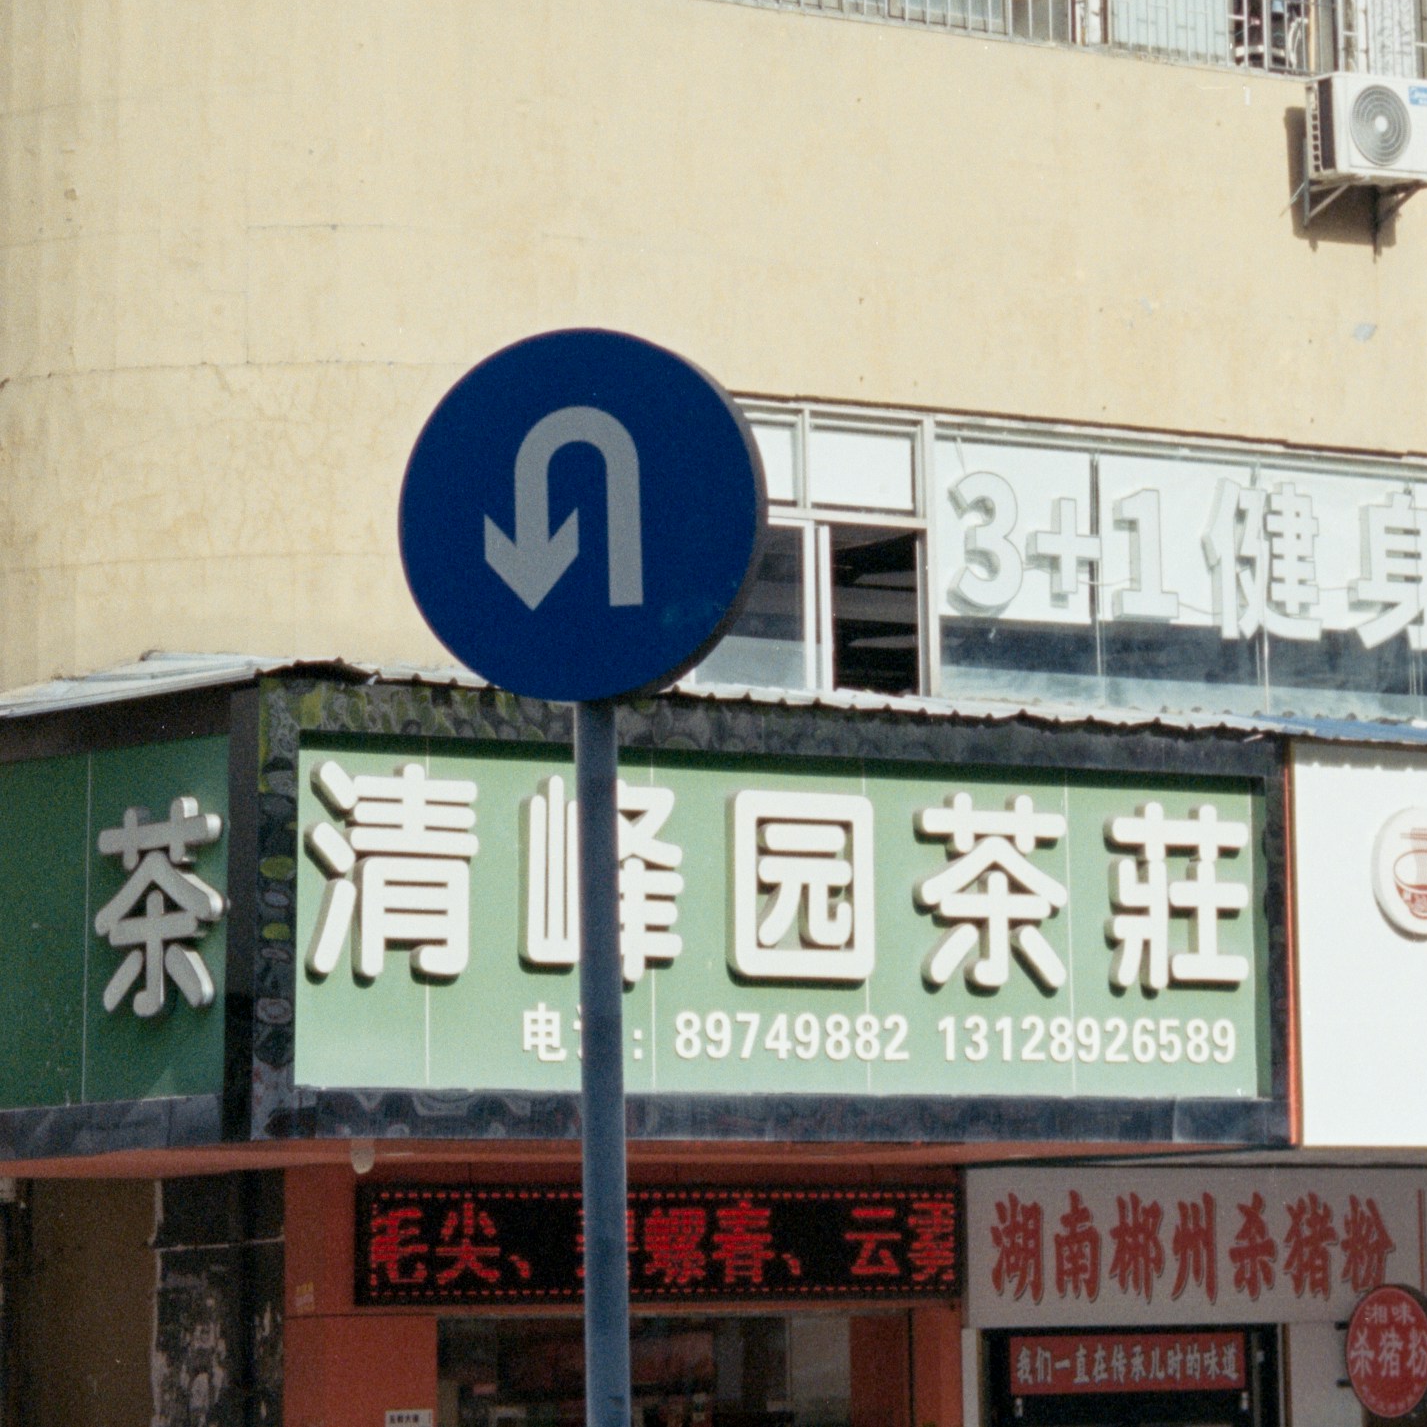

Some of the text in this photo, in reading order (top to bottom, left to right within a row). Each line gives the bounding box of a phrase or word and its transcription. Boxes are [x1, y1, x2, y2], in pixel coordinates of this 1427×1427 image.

[95, 796, 230, 1018] 茶
[674, 1010, 910, 1063] 89749882
[937, 1016, 1236, 1065] 13128926589
[990, 1190, 1395, 1304] 湖南郴州杀猪粉
[1364, 1302, 1416, 1326] 湘味
[1015, 1344, 1240, 1385] 我们一直在传承儿时的味道
